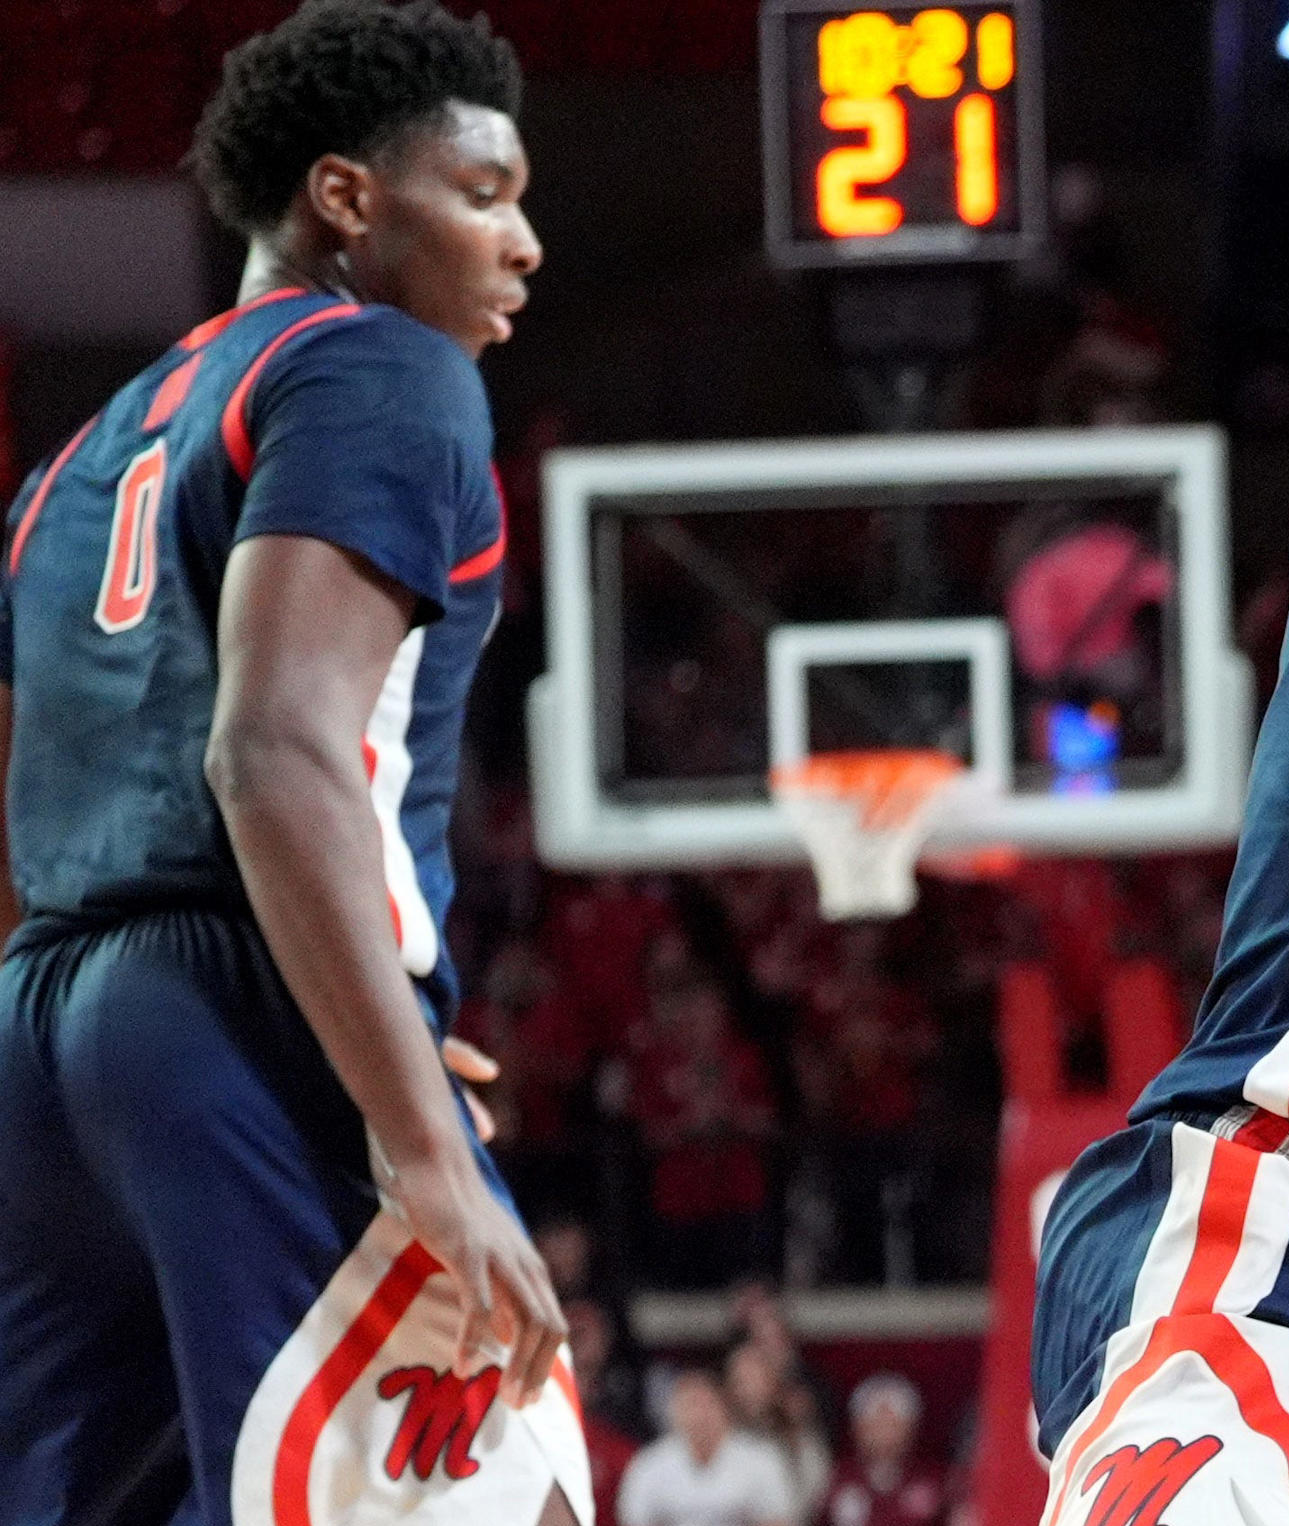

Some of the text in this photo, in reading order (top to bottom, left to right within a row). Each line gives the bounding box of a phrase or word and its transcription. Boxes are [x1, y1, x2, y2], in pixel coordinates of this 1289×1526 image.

[815, 92, 999, 238] 21
[93, 436, 168, 635] 0
[377, 1363, 502, 1481] M
